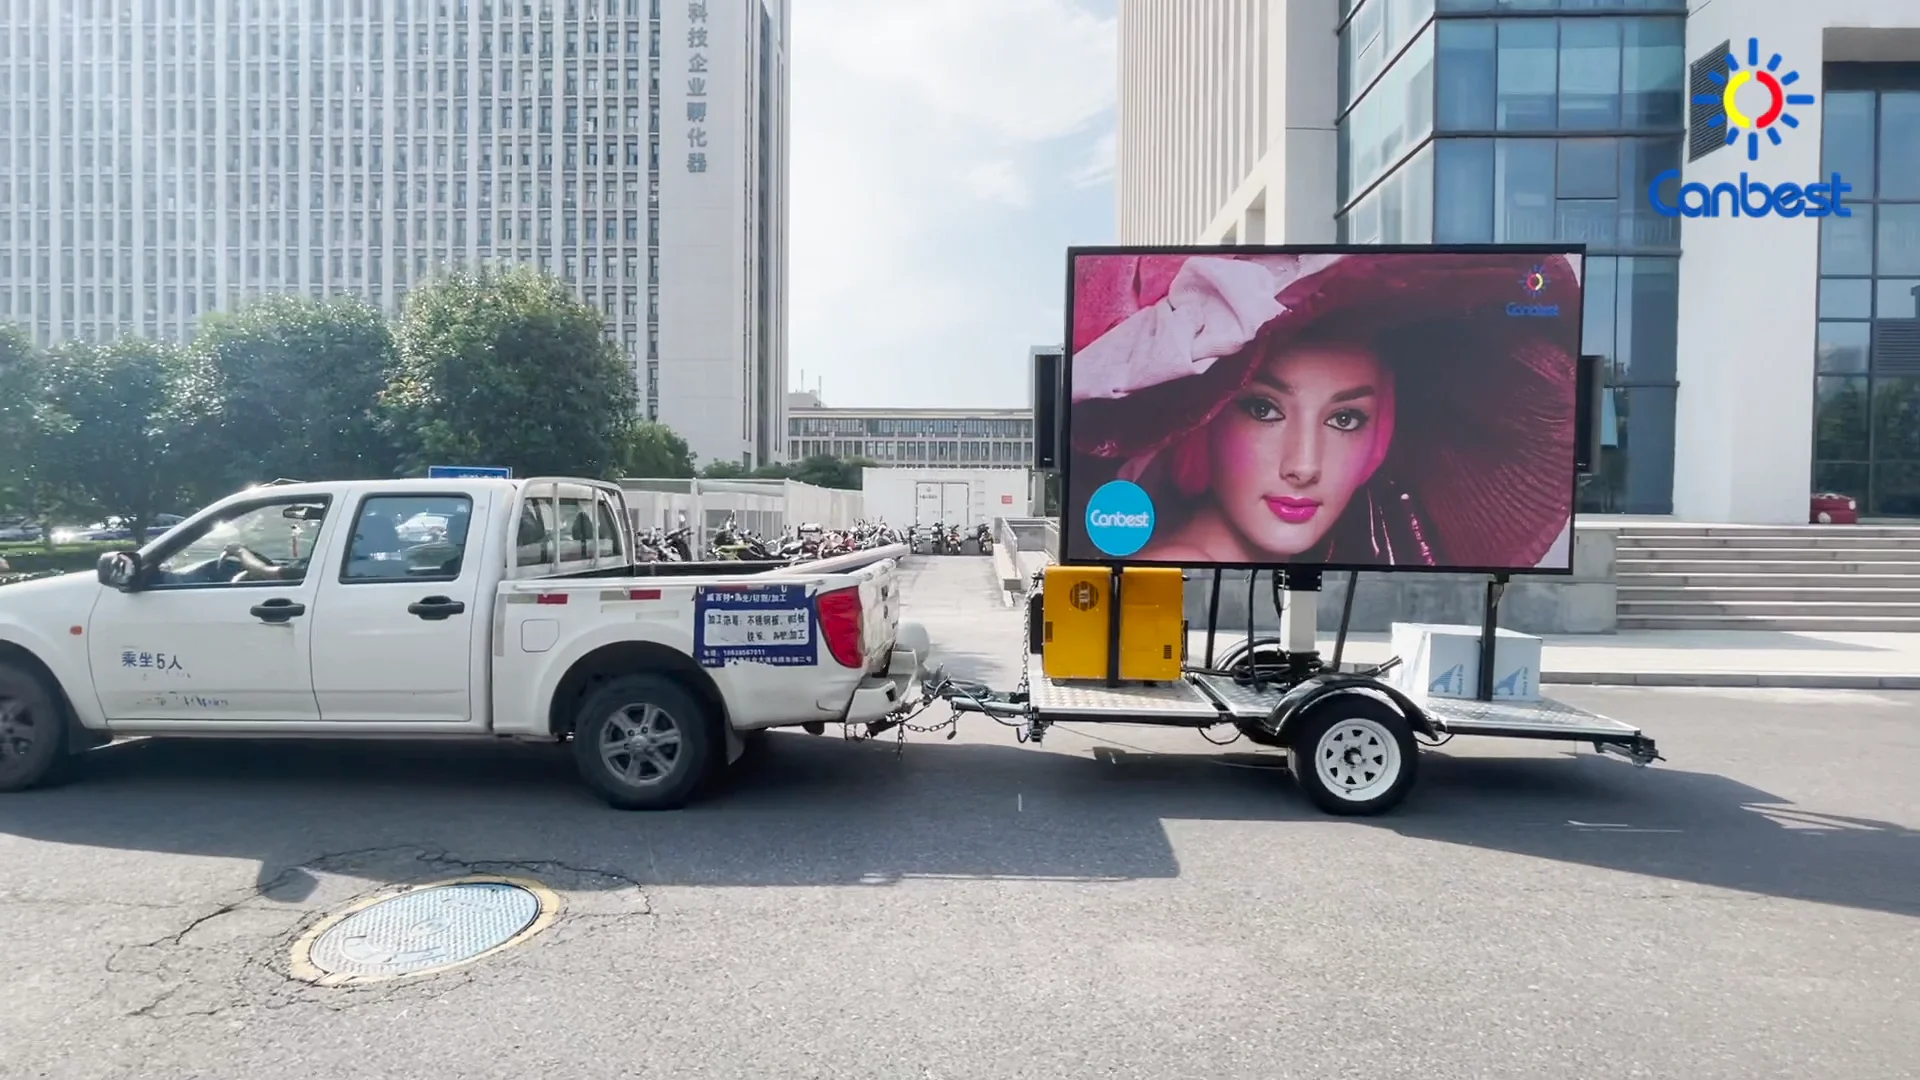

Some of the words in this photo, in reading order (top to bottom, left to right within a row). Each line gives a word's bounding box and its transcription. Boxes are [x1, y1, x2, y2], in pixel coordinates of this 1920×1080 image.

[1090, 509, 1150, 528] Canbest
[122, 651, 182, 669] 乘坐5人
